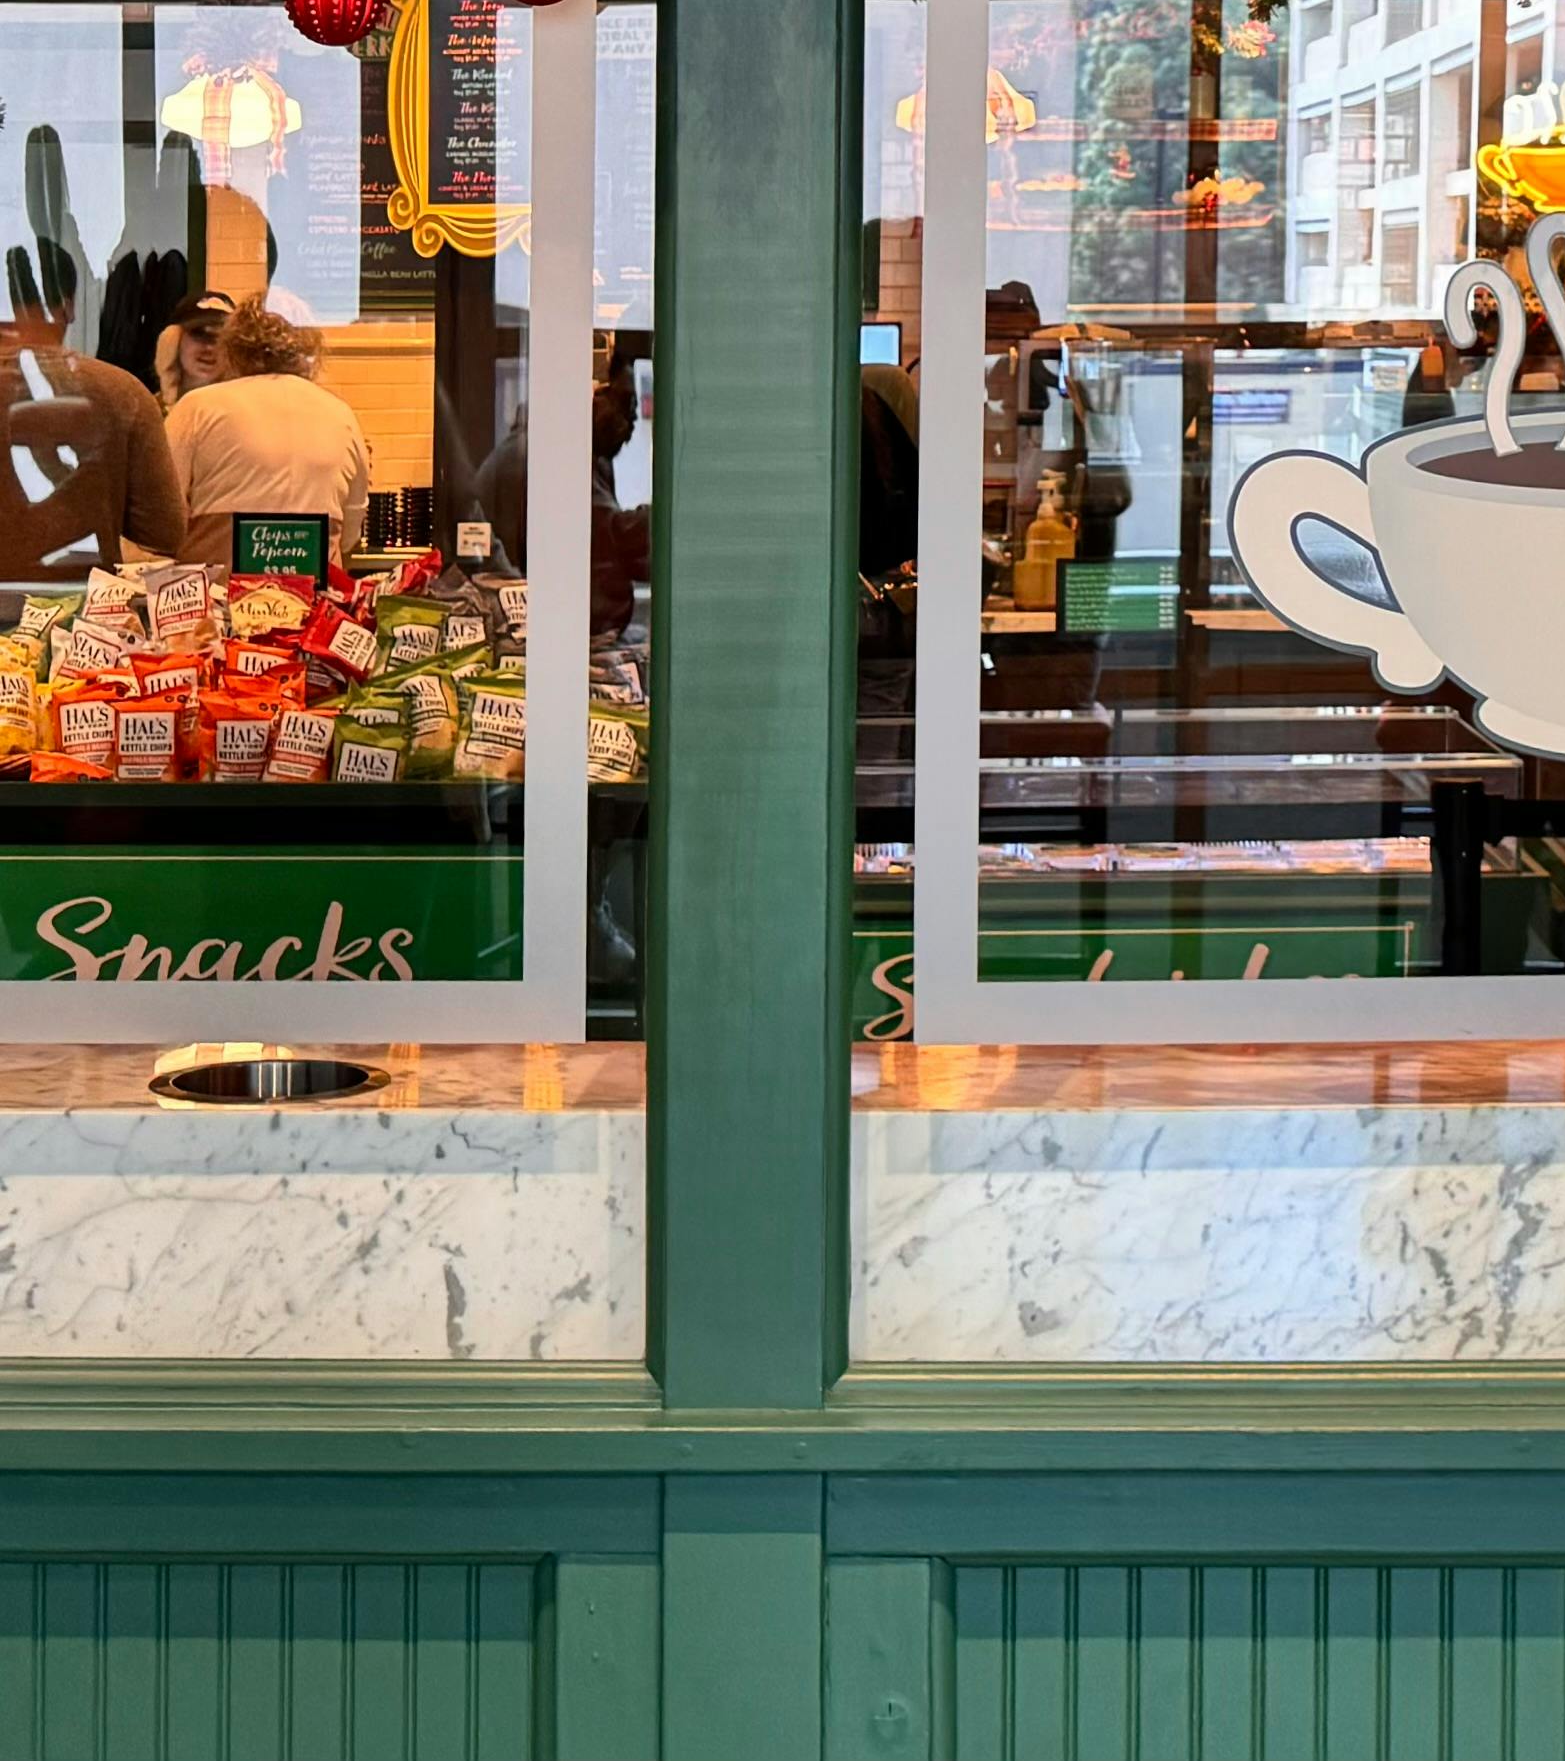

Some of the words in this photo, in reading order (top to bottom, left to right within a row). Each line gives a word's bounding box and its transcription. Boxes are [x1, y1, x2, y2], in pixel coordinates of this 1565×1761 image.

[251, 526, 291, 545] Chips
[252, 542, 308, 561] Popcorn
[66, 706, 109, 727] HAL'S
[481, 698, 524, 719] HAL'S
[125, 717, 168, 736] HAL'S
[224, 725, 265, 743] HAL'S
[285, 714, 327, 738] HAL'S
[64, 732, 90, 743] KETTLE
[120, 743, 148, 752] KETTLE
[346, 749, 389, 771] HAL'S
[36, 895, 413, 981] Snacks
